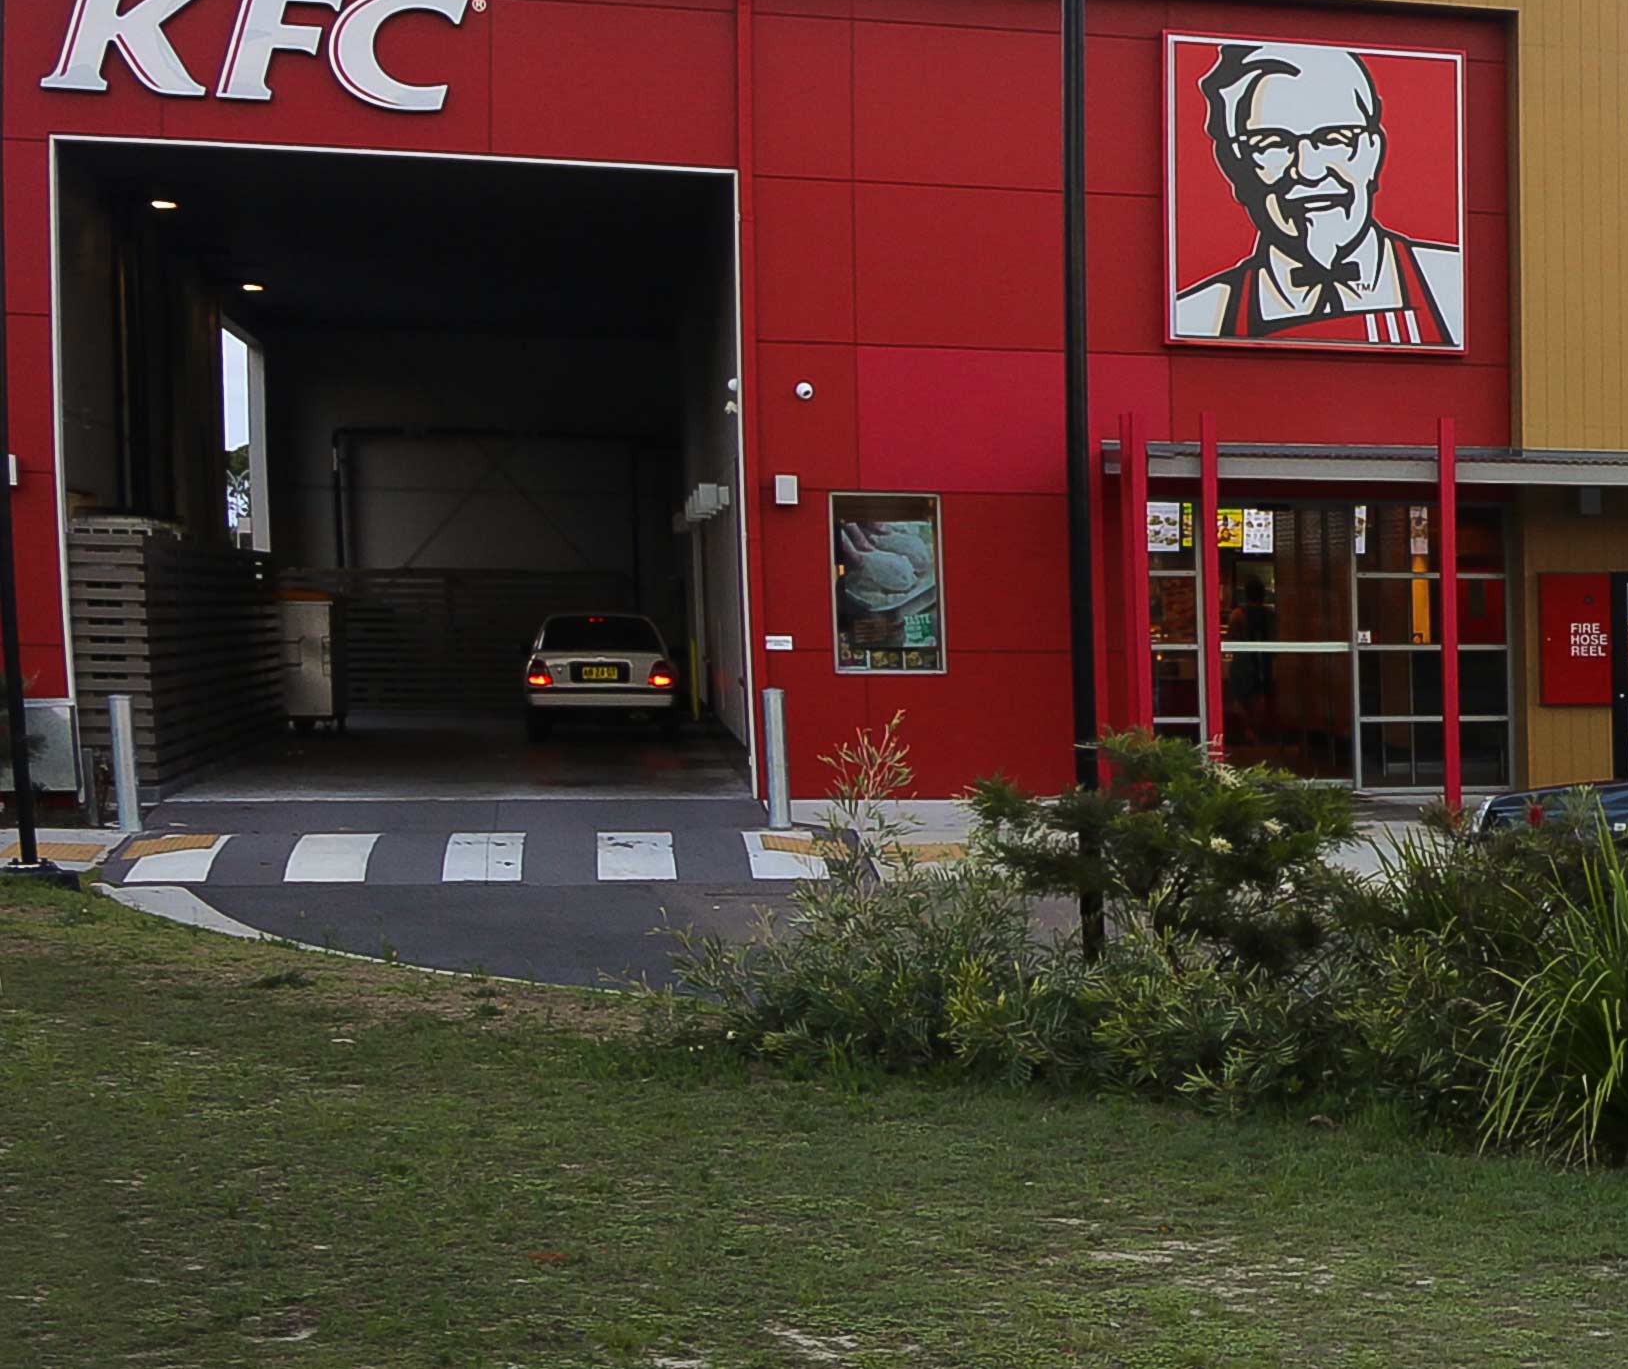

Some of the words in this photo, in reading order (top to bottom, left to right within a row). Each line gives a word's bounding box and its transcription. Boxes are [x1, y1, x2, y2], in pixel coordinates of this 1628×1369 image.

[904, 613, 932, 626] TASTE
[1570, 622, 1601, 634] FIRE
[1570, 634, 1609, 646] HOSE
[1570, 645, 1607, 657] REEL
